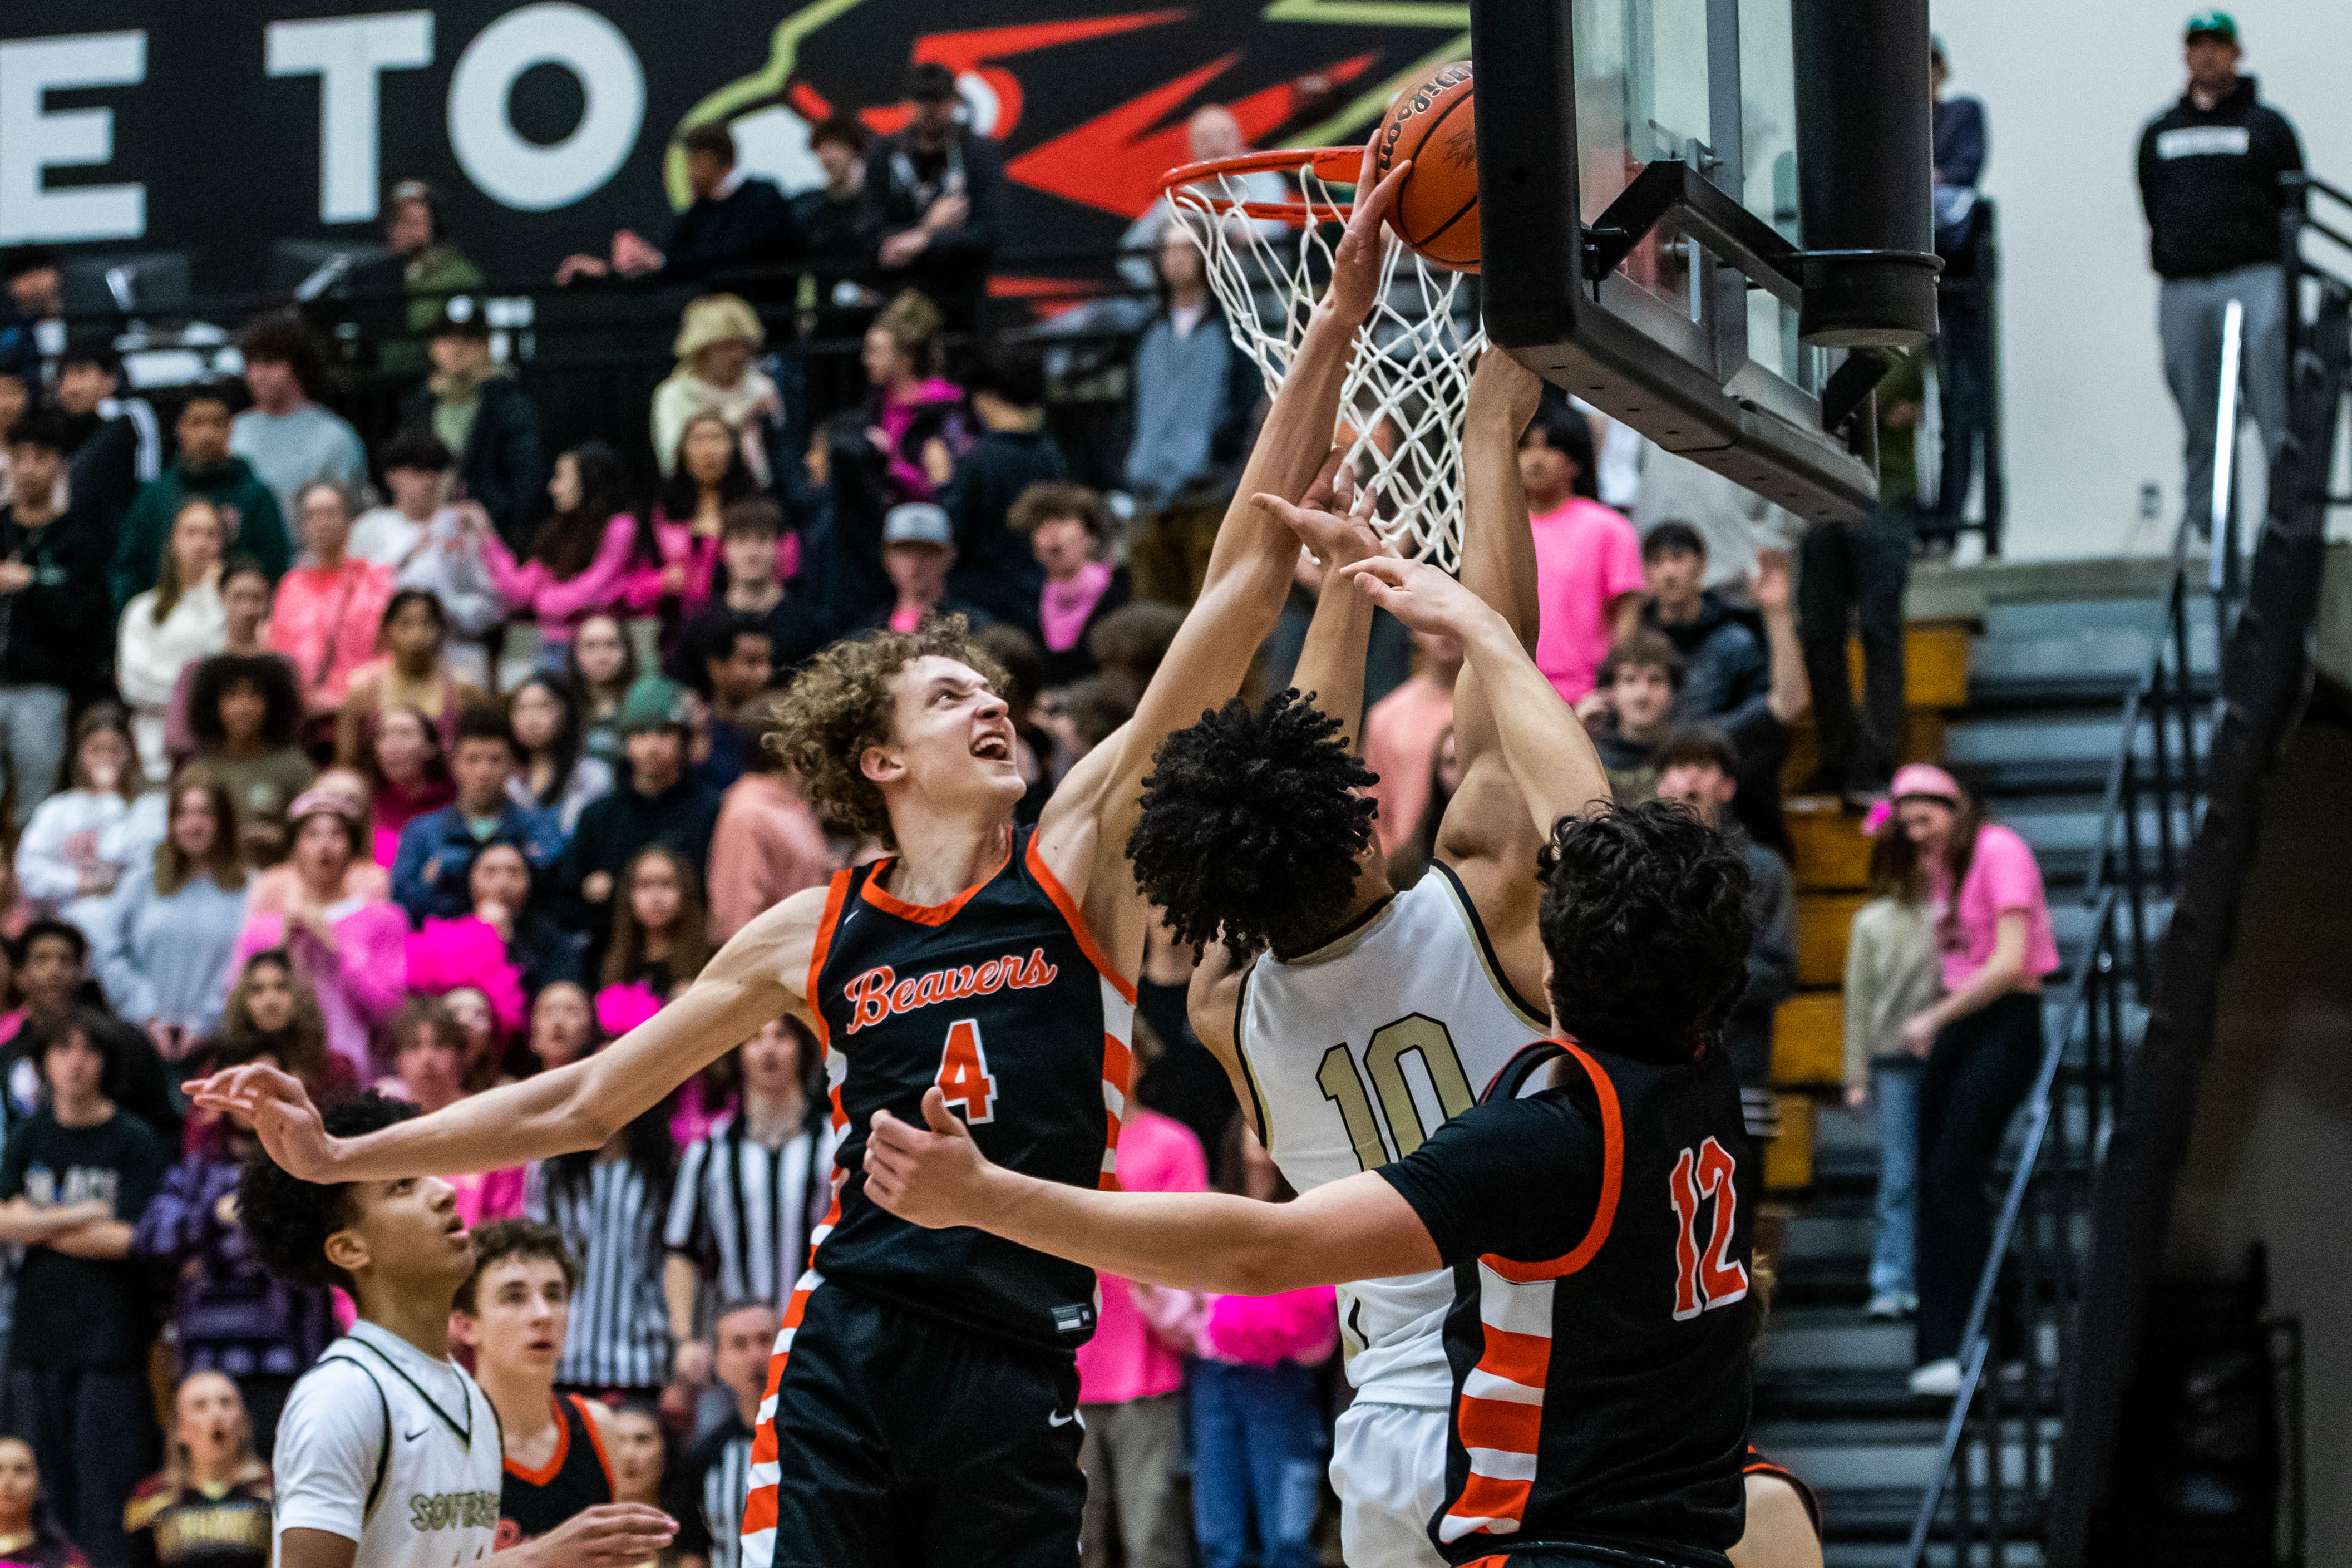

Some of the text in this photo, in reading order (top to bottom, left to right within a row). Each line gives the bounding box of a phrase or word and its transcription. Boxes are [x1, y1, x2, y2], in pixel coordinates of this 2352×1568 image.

[0, 1, 647, 247] E TO
[844, 948, 1058, 1034] Beavers
[934, 1018, 998, 1125] 4
[1315, 1012, 1477, 1172] 10
[1669, 1135, 1749, 1321] 12
